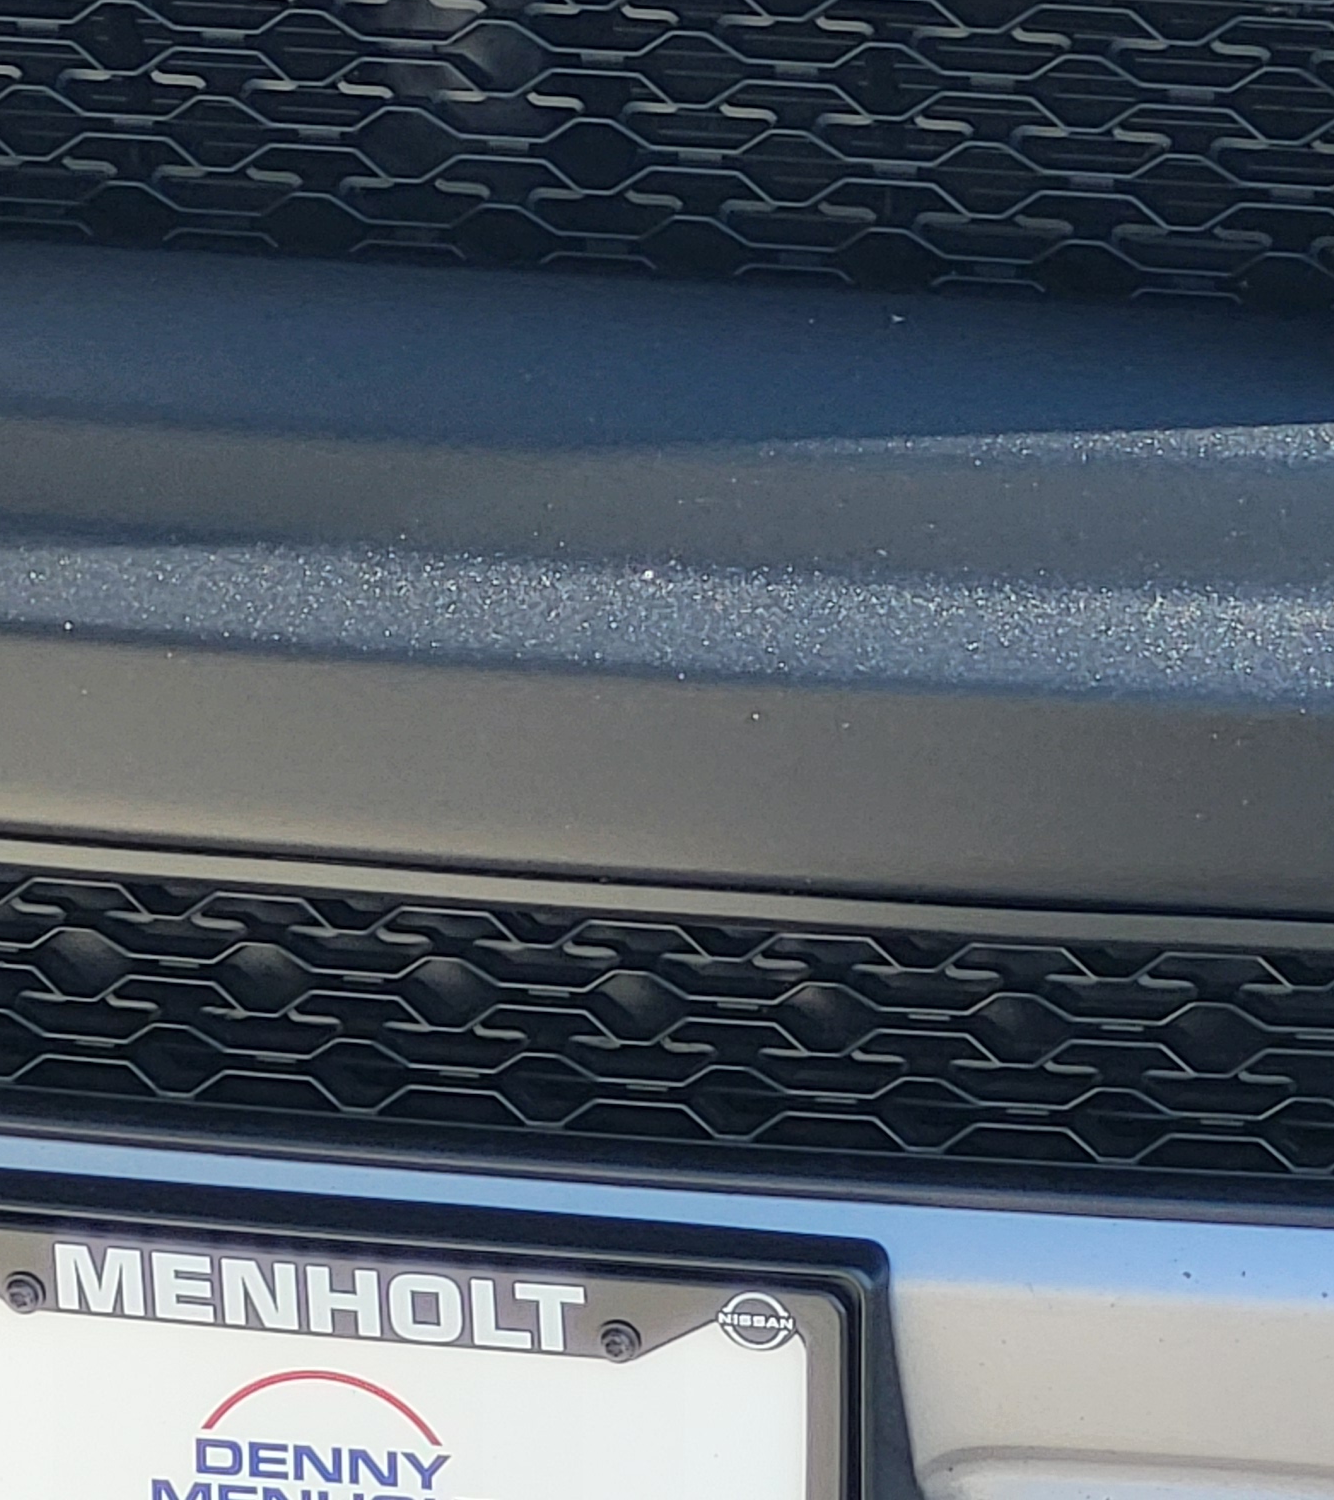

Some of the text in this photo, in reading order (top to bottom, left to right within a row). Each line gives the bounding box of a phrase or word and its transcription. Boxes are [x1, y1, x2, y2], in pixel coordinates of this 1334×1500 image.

[53, 1242, 586, 1352] MENHOLT
[718, 1312, 794, 1330] NISSAN
[196, 1437, 452, 1491] DENNY
